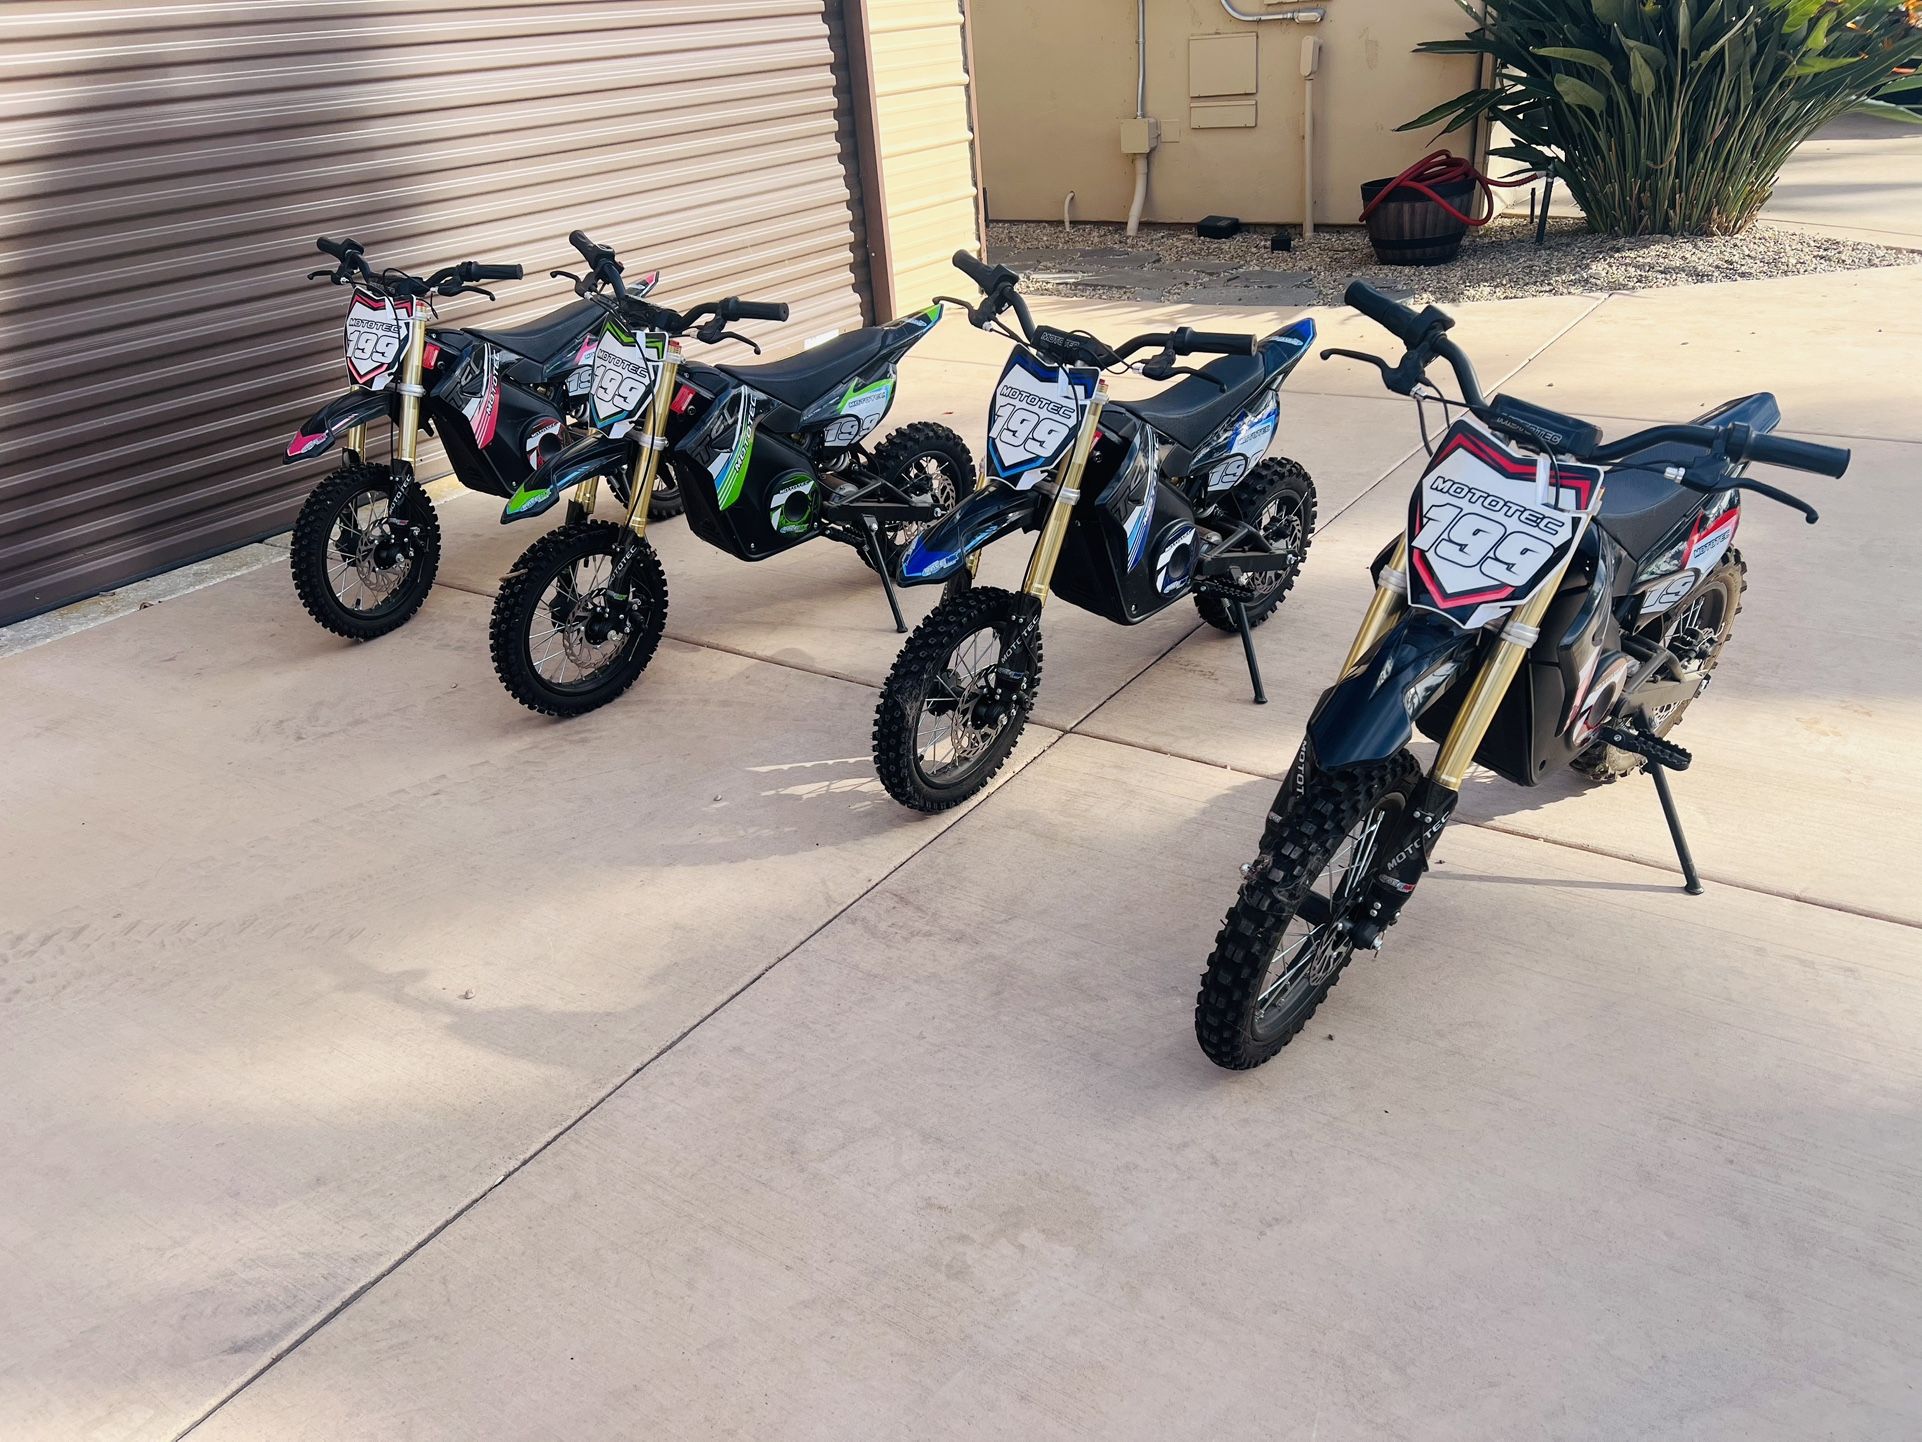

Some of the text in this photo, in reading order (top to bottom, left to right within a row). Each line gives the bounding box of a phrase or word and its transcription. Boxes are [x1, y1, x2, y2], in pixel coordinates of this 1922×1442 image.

[346, 330, 400, 364] 199
[349, 317, 402, 333] MOTOTEC
[590, 364, 648, 411] 199
[597, 349, 648, 379] MOTOTEC
[1000, 385, 1076, 420] MOTOTEC
[733, 393, 758, 474] MOTOTEC
[989, 402, 1070, 458] 199
[1430, 476, 1565, 536] MOTOTEC
[1411, 503, 1555, 588] 199
